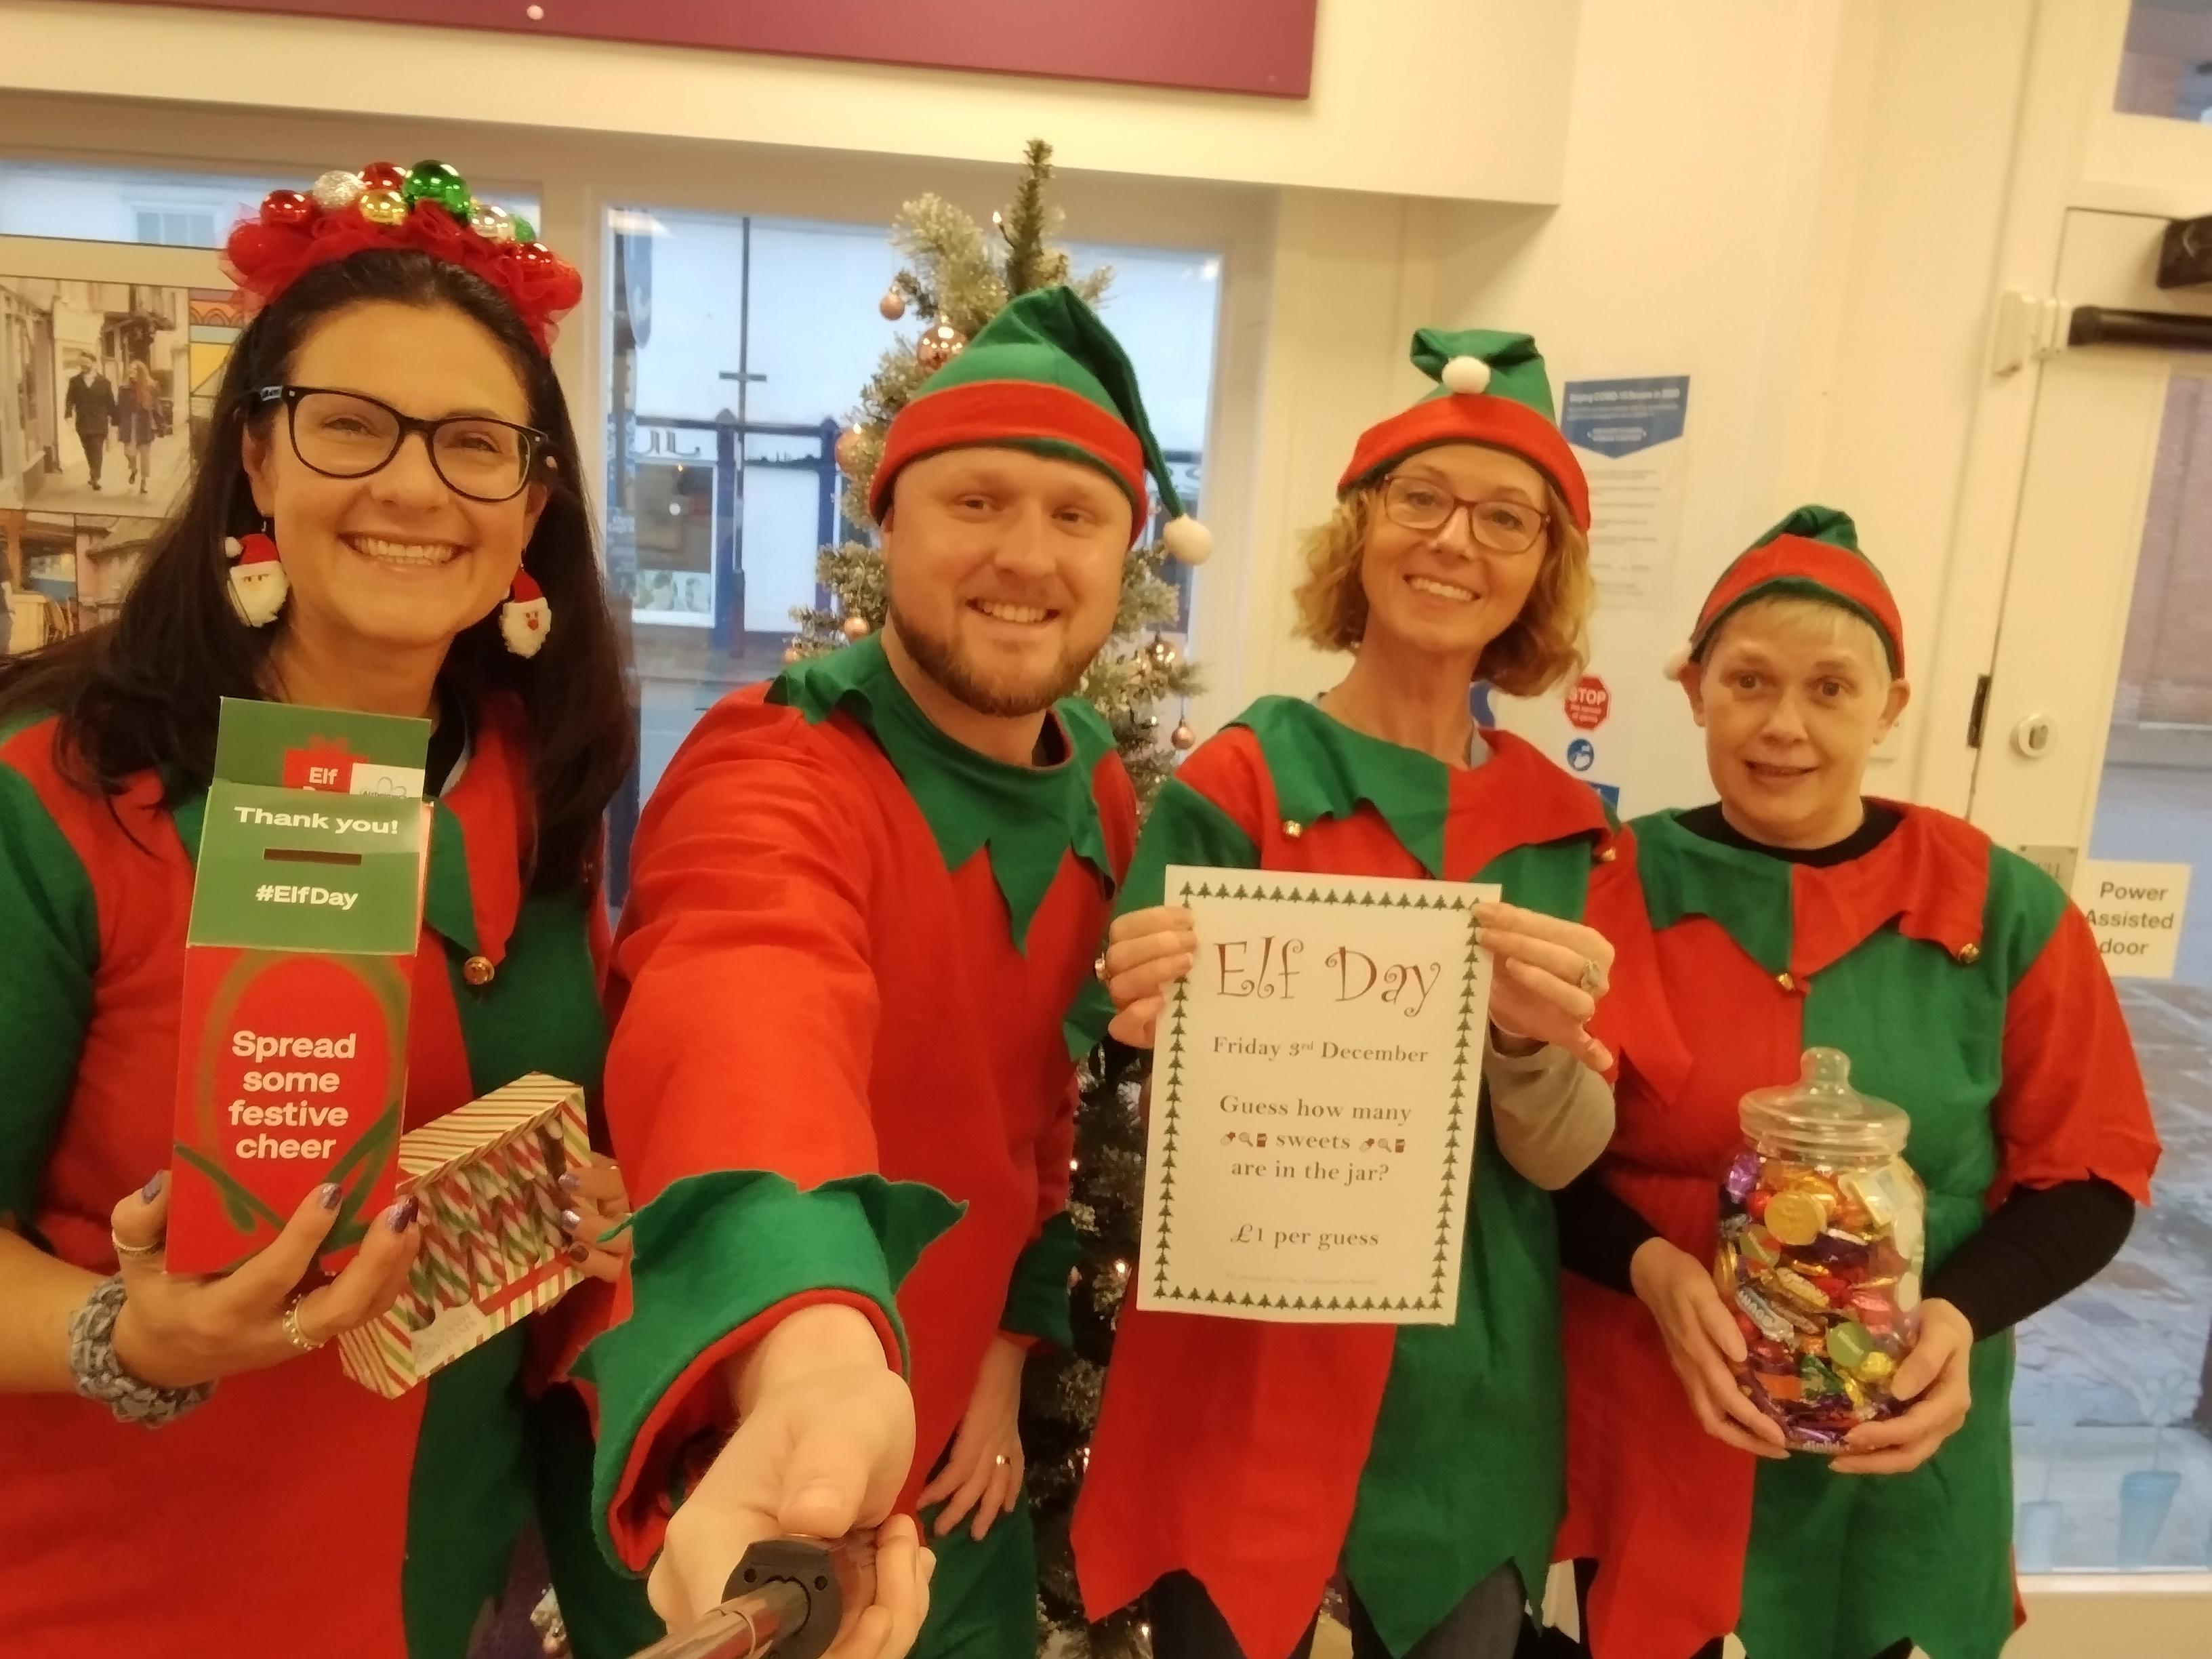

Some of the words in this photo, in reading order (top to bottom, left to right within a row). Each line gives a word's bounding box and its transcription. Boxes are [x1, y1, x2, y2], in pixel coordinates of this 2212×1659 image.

[309, 766, 339, 785] Elf
[234, 806, 329, 830] Thank
[335, 818, 398, 835] you!
[255, 884, 359, 911] #ElfDay
[2100, 882, 2169, 901] Power
[2087, 909, 2175, 929] Assisted
[2100, 938, 2149, 956] door
[1213, 935, 1305, 1001] Elf
[1324, 945, 1441, 1018] Day
[231, 1031, 356, 1063] Spread
[1213, 1036, 1282, 1061] Friday
[1288, 1040, 1315, 1061] 3rd
[1321, 1041, 1429, 1063] December
[242, 1071, 340, 1093] some
[228, 1100, 349, 1128] festive
[1219, 1095, 1289, 1117] Guess
[1296, 1099, 1345, 1119] how
[1352, 1104, 1412, 1126] many
[235, 1133, 337, 1160] cheer
[1276, 1132, 1351, 1151] sweets
[1231, 1163, 1267, 1179] are
[1275, 1160, 1296, 1179] in
[1304, 1162, 1340, 1181] the
[1345, 1162, 1389, 1187] jar?
[1230, 1223, 1263, 1244] £1
[1274, 1229, 1312, 1249] per
[1318, 1230, 1379, 1250] guess
